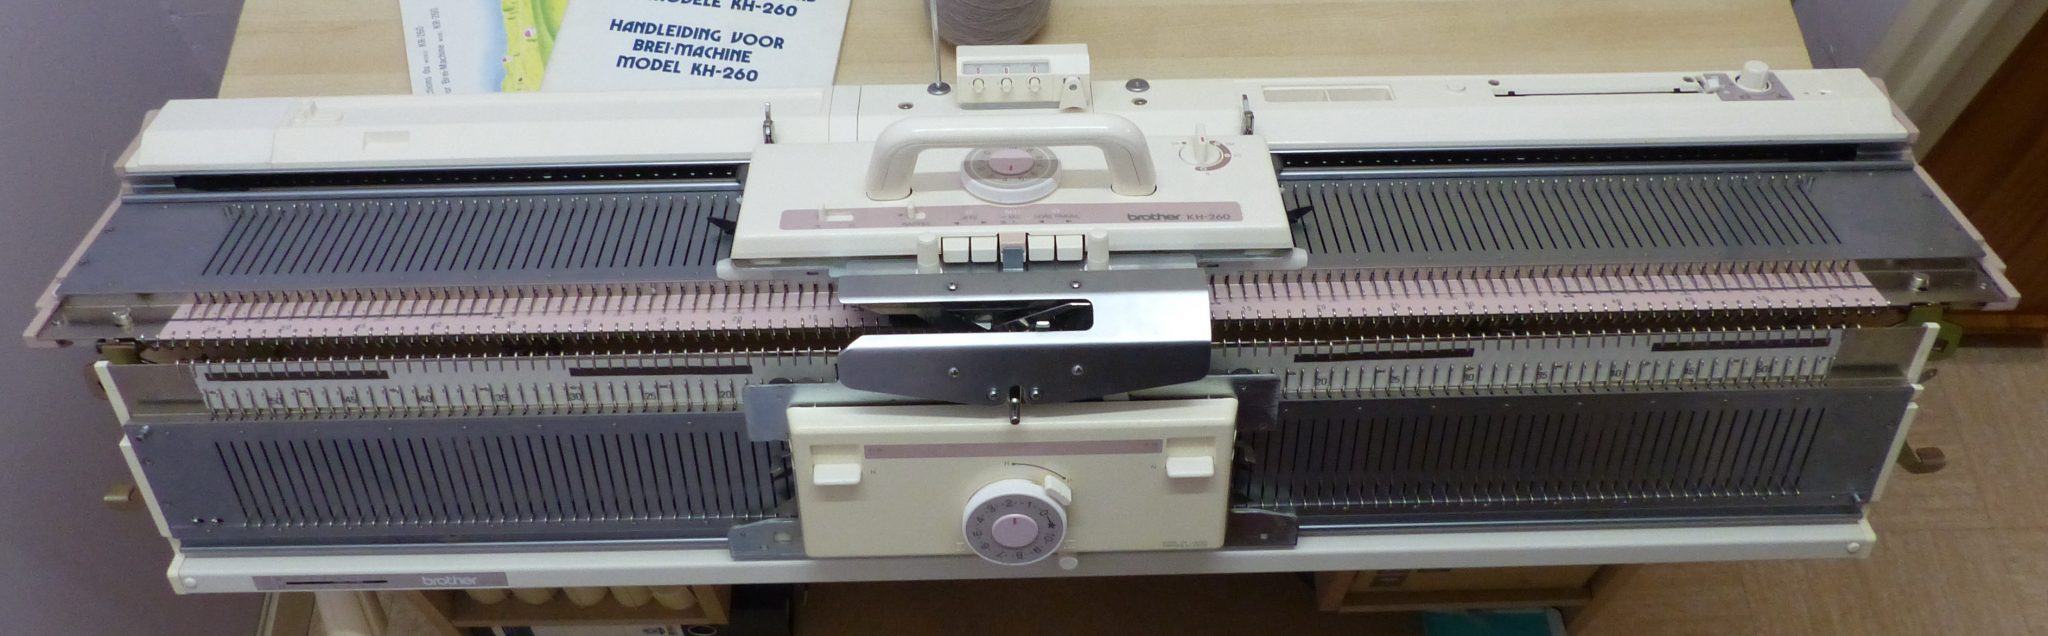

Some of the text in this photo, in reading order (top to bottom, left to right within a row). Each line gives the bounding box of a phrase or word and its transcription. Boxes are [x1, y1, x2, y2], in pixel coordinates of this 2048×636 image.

[731, 0, 798, 17] KH-260
[609, 18, 785, 49] HANDLEIDING VOOR
[616, 55, 759, 82] MODEL KH-260
[1127, 213, 1231, 222] brother KH-260
[1005, 499, 1014, 507] 2
[986, 505, 996, 513] 3
[976, 516, 985, 524] 4
[422, 576, 479, 586] brother
